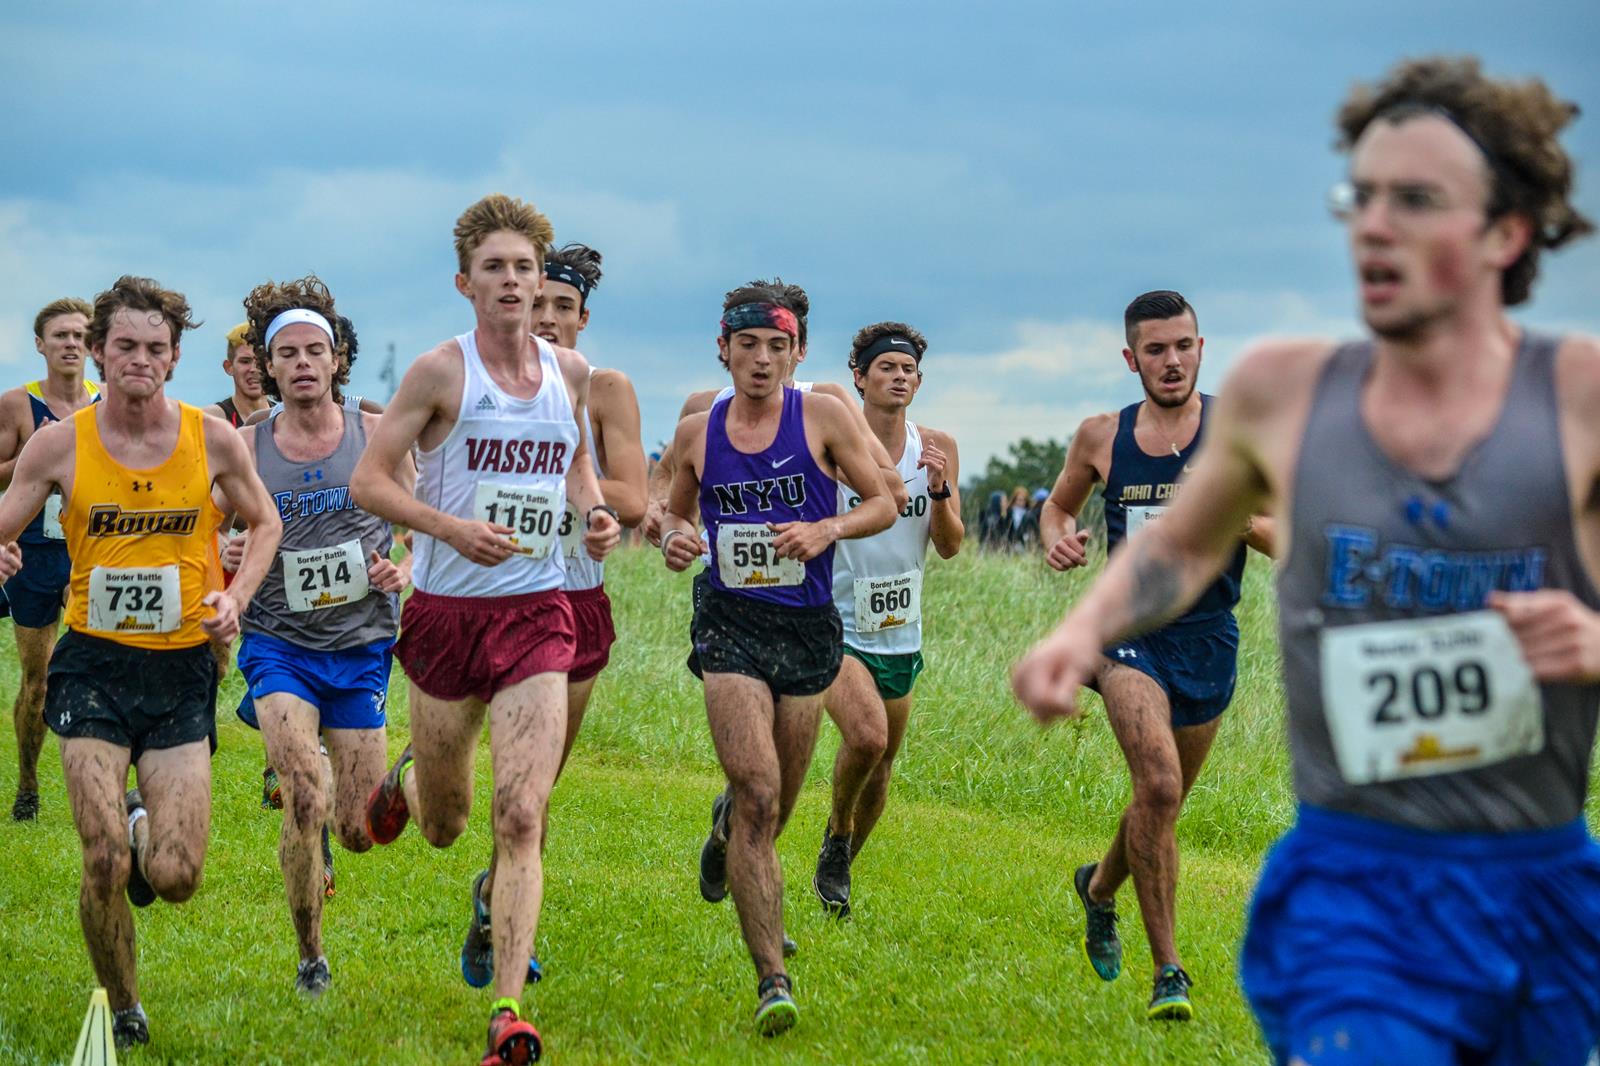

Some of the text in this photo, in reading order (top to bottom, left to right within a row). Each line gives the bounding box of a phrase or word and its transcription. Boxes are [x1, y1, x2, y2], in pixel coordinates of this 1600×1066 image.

[465, 438, 566, 475] VASSAR
[497, 490, 549, 505] Border Battle
[713, 473, 807, 515] NYU
[1119, 485, 1153, 501] JOHN
[89, 504, 200, 537] Rowan
[485, 502, 553, 536] 1150
[558, 511, 573, 536] 3
[733, 529, 758, 537] Border
[297, 550, 346, 565] Border Battle
[106, 573, 162, 582] Border Battle
[299, 561, 351, 592] 214
[870, 576, 911, 590] Border Battle
[105, 585, 163, 612] 732
[870, 587, 911, 614] 660
[1366, 661, 1497, 727] 209
